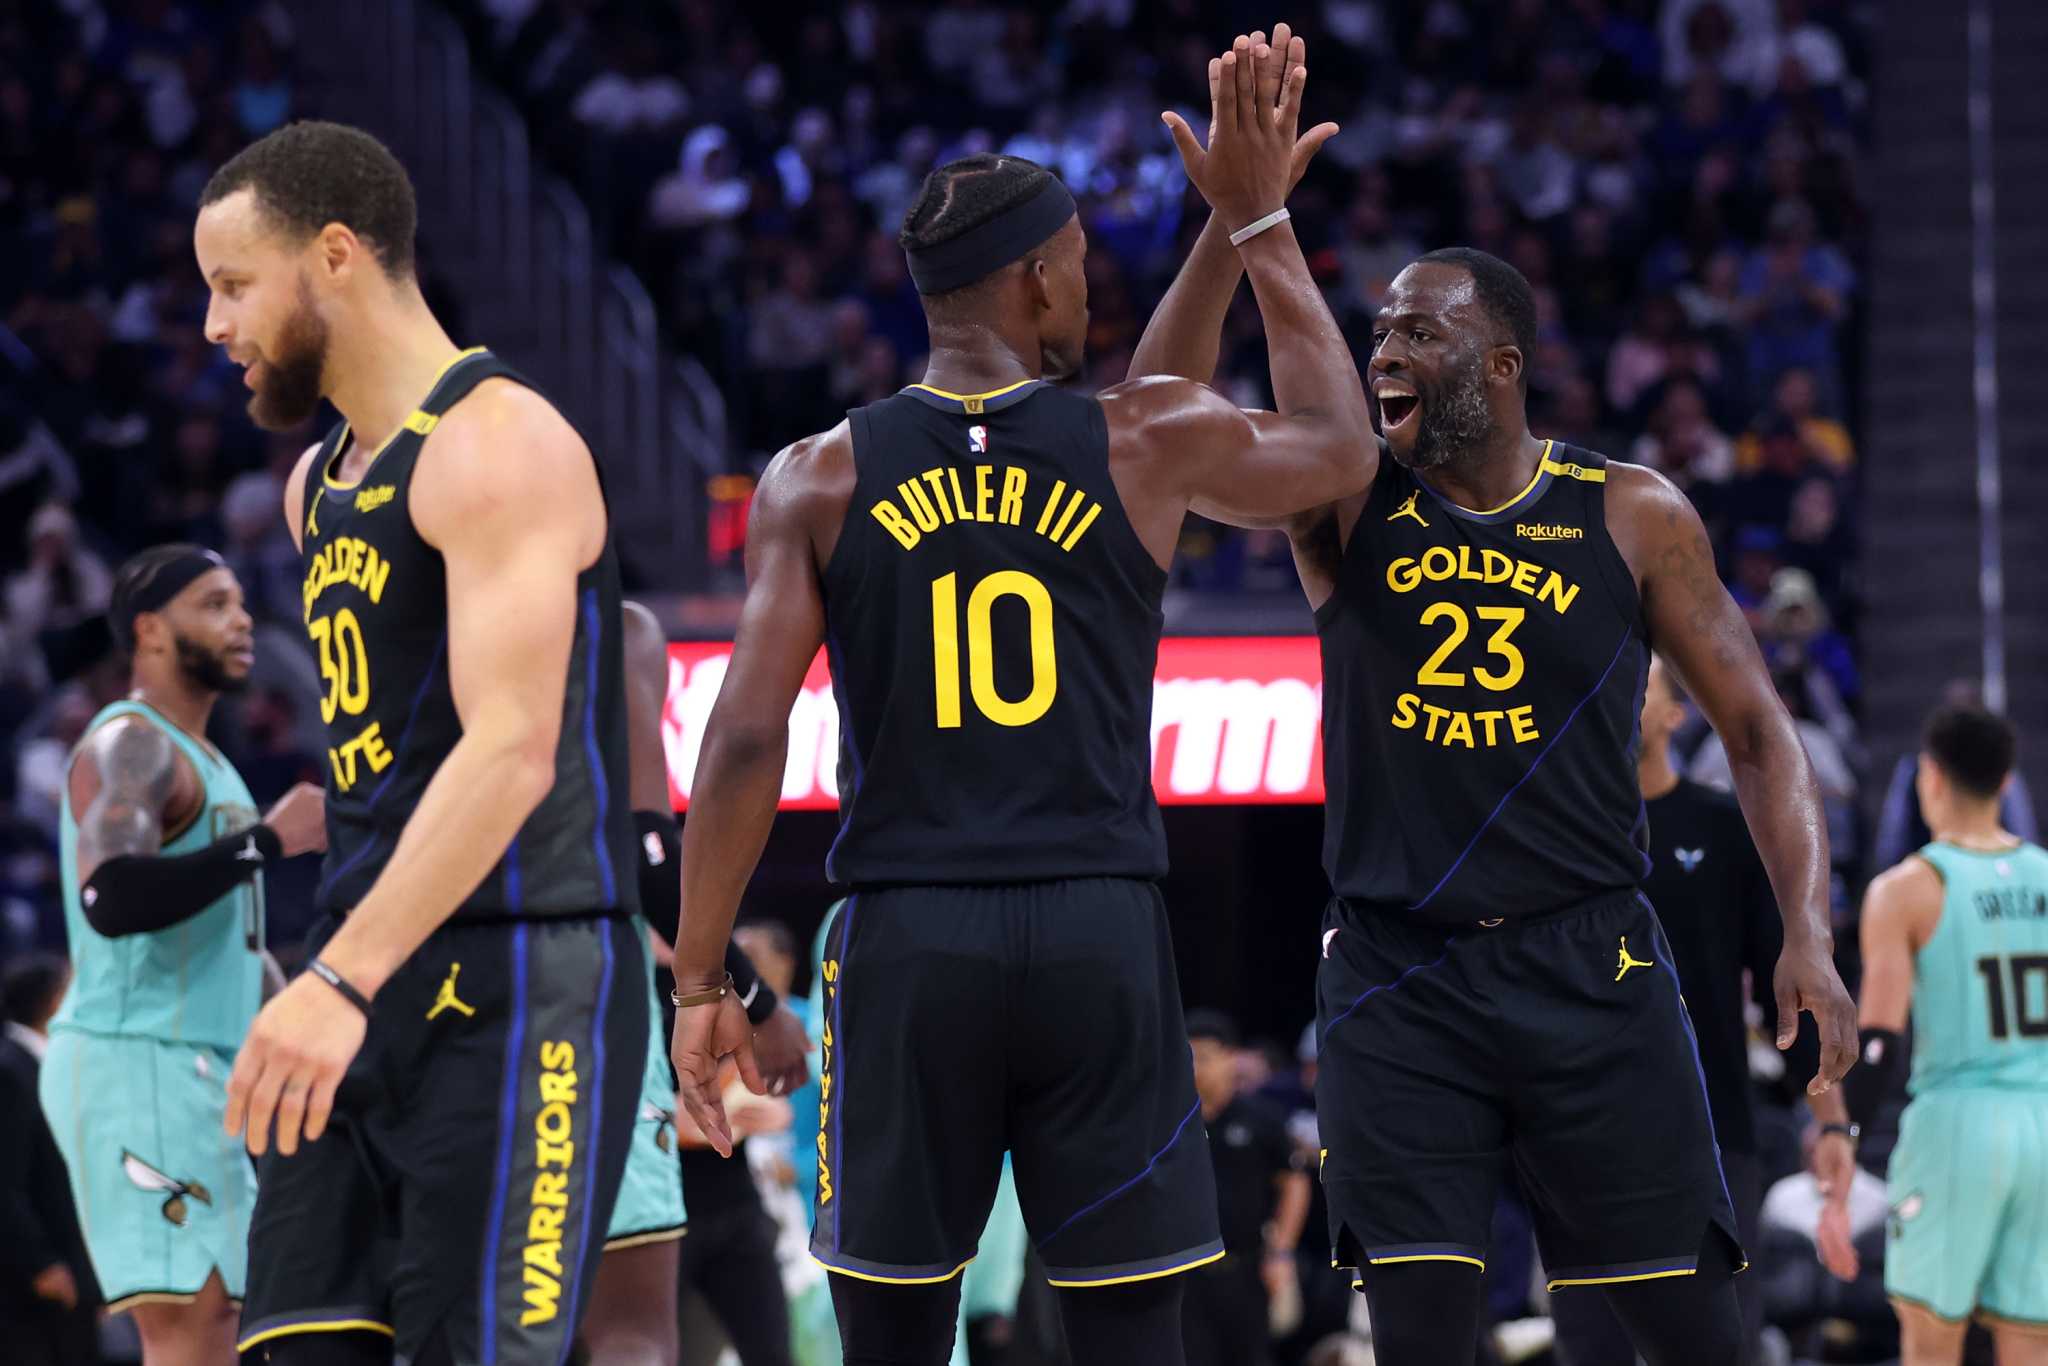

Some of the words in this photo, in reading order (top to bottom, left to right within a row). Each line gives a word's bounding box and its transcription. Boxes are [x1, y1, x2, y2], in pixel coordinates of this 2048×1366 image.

[870, 465, 1028, 551] BUTLER
[1035, 480, 1102, 552] III
[1567, 465, 1582, 478] 16
[1516, 523, 1583, 539] Rakuten
[1386, 545, 1580, 615] GOLDEN
[309, 608, 369, 724] 30
[932, 570, 1057, 728] 10
[1417, 601, 1525, 691] 23
[1391, 693, 1540, 749] STATE
[1977, 957, 2048, 1041] 10
[520, 1040, 578, 1327] WARRIORS
